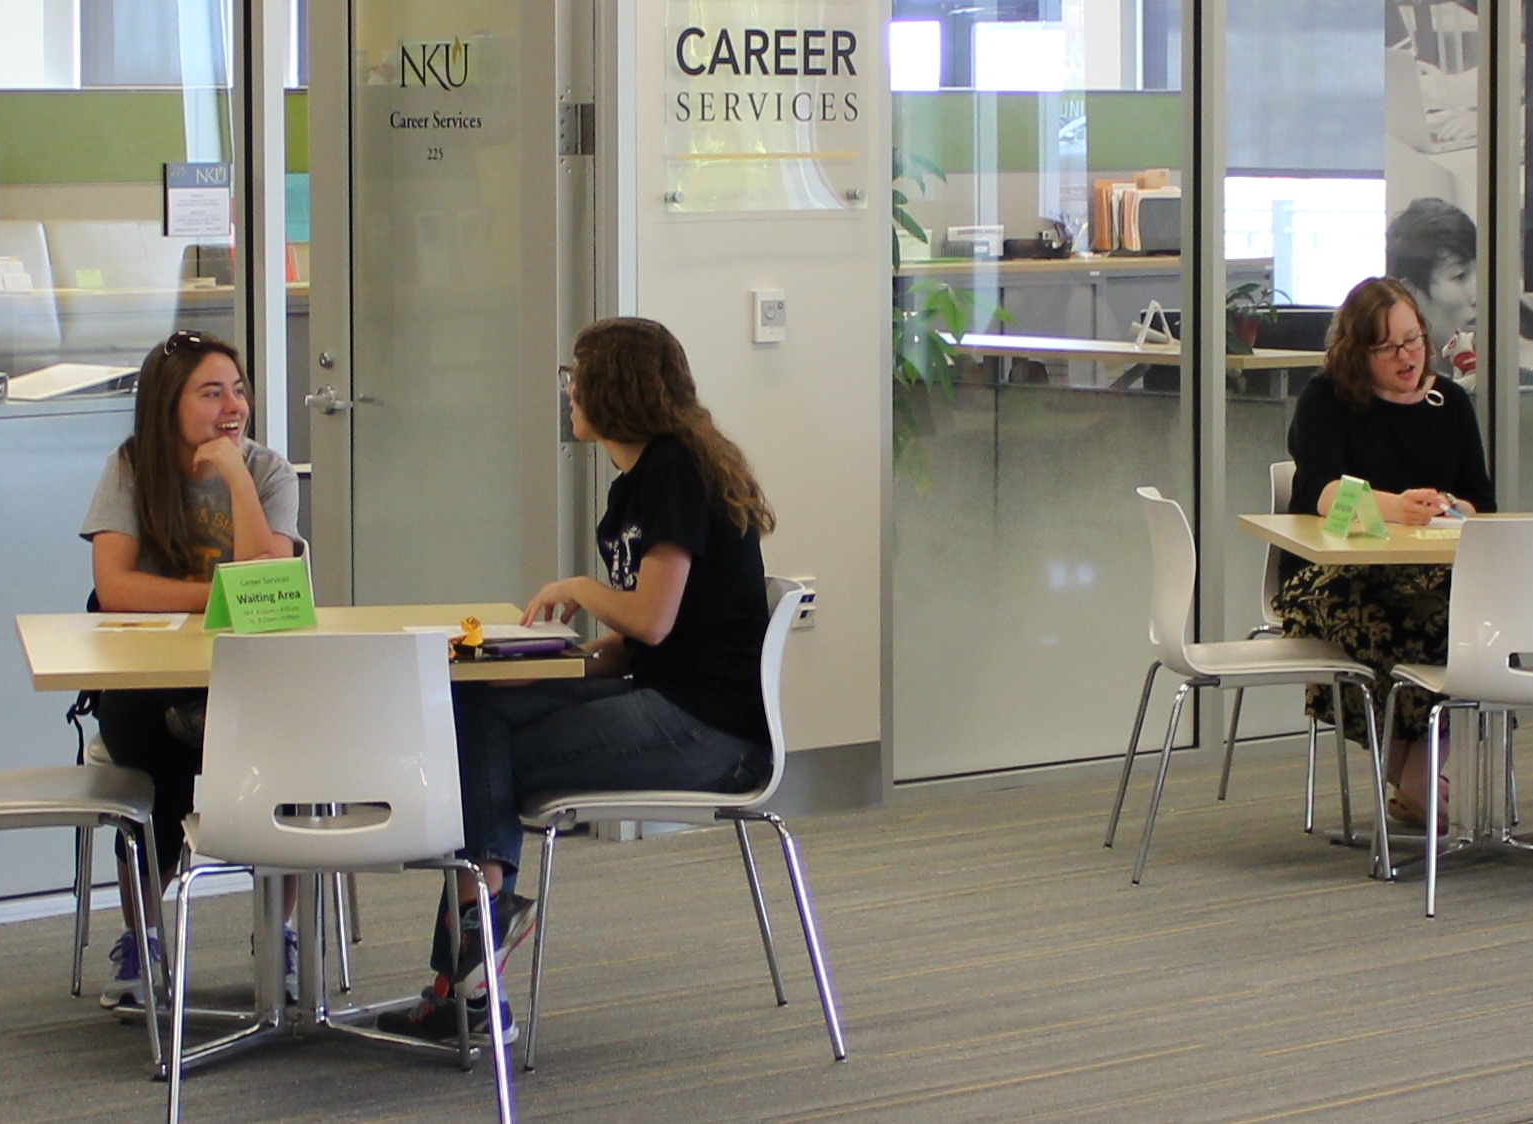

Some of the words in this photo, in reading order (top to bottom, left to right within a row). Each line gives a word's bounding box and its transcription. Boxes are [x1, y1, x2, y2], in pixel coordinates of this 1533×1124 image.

[675, 27, 858, 76] CAREER
[399, 40, 470, 92] NKU
[675, 91, 859, 123] SERVICES
[389, 110, 430, 129] Career
[432, 110, 482, 129] Services
[427, 147, 444, 160] 225
[196, 165, 227, 185] NKU
[235, 591, 276, 605] Waiting
[277, 590, 301, 600] Area
